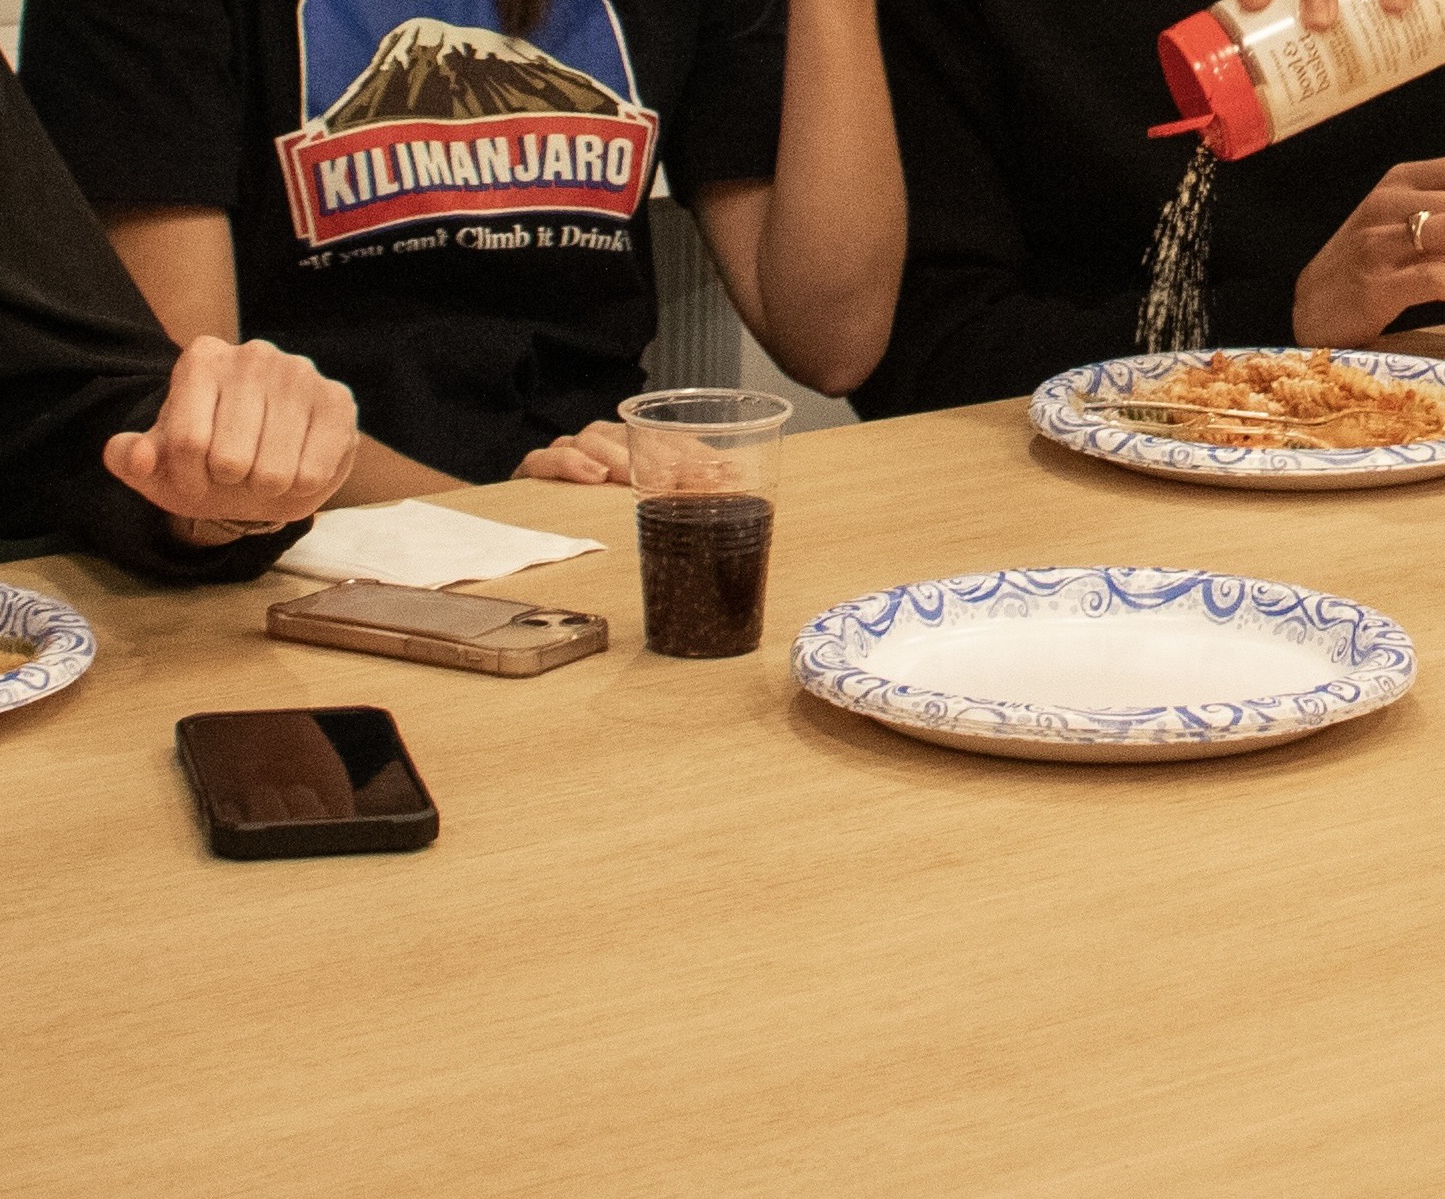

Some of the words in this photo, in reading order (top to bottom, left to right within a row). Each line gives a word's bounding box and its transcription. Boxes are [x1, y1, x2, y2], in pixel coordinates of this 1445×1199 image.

[316, 133, 634, 212] KILIMANJARO
[455, 223, 532, 251] Climb
[536, 225, 554, 248] it
